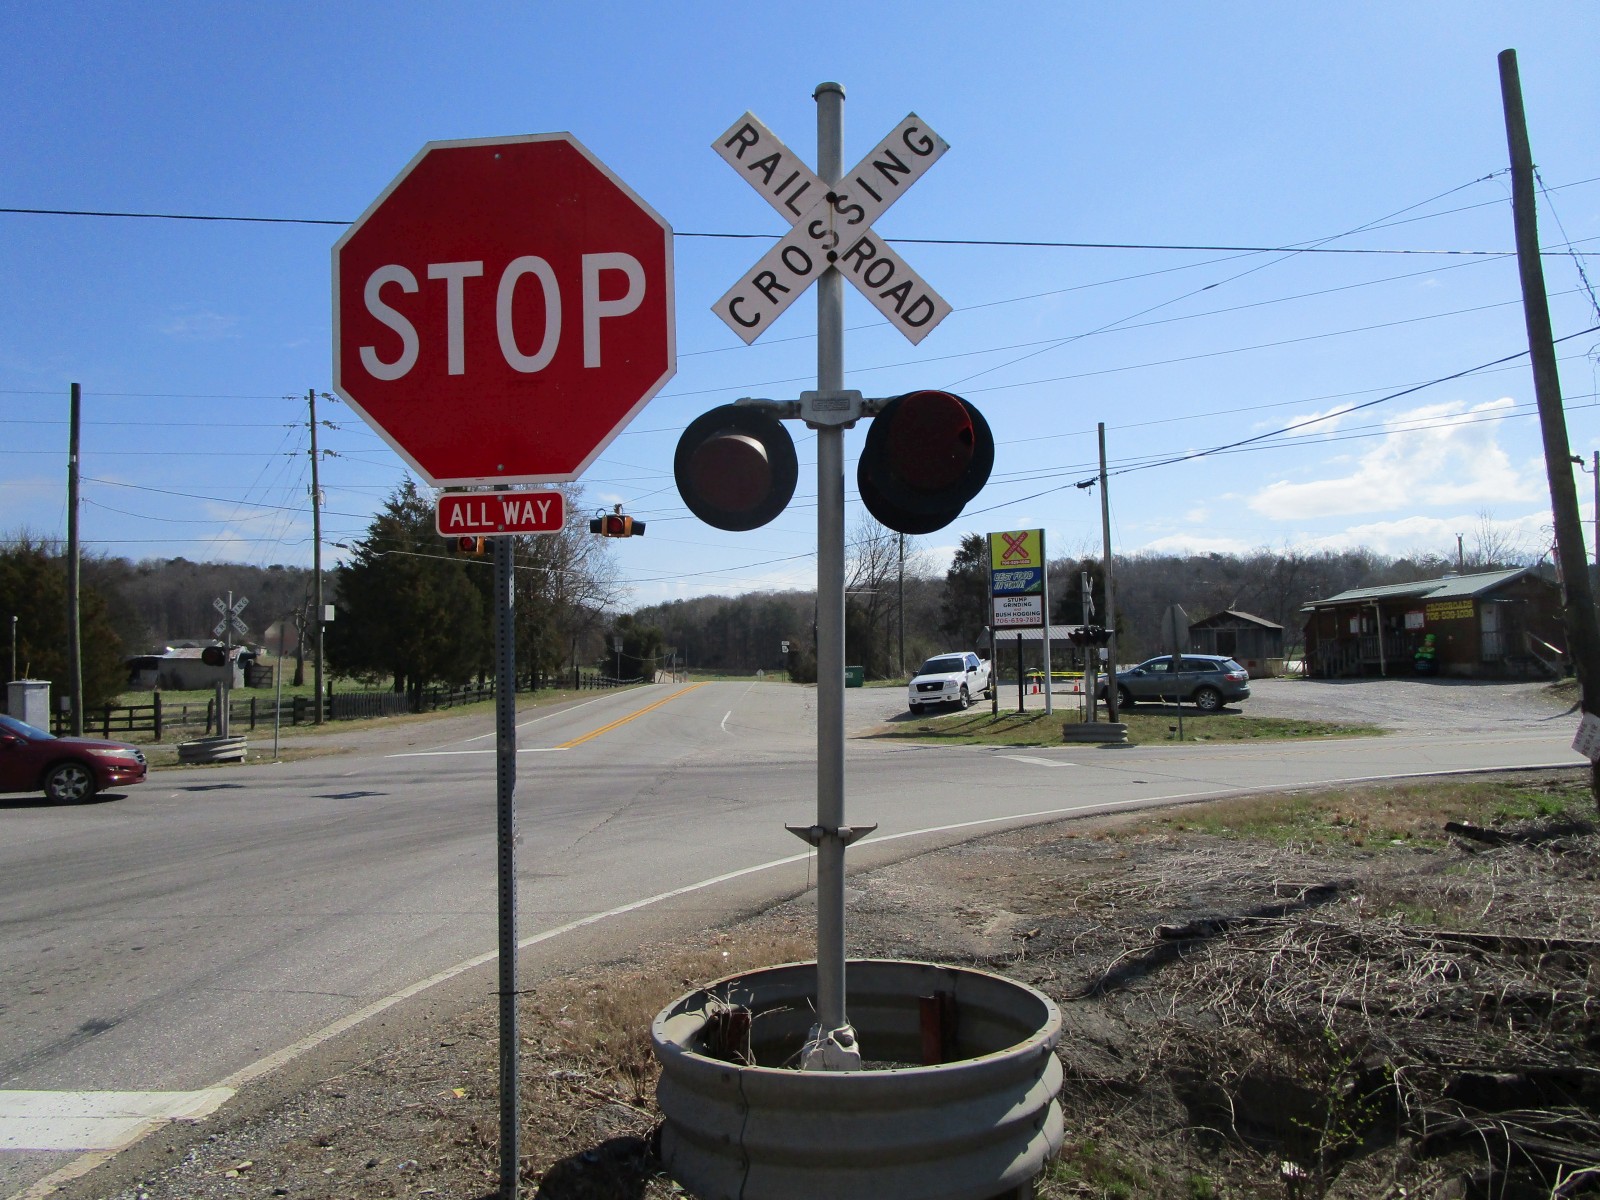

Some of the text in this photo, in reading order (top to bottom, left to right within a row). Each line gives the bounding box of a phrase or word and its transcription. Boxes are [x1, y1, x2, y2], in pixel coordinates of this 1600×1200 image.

[724, 123, 935, 328] RAIL ROAD
[728, 126, 934, 328] CROSSING
[359, 252, 646, 381] STOP
[449, 500, 552, 527] ALL WAY
[994, 571, 1033, 581] BEST FOOD
[994, 581, 1004, 590] IN
[1426, 601, 1472, 611] CROSSROADS
